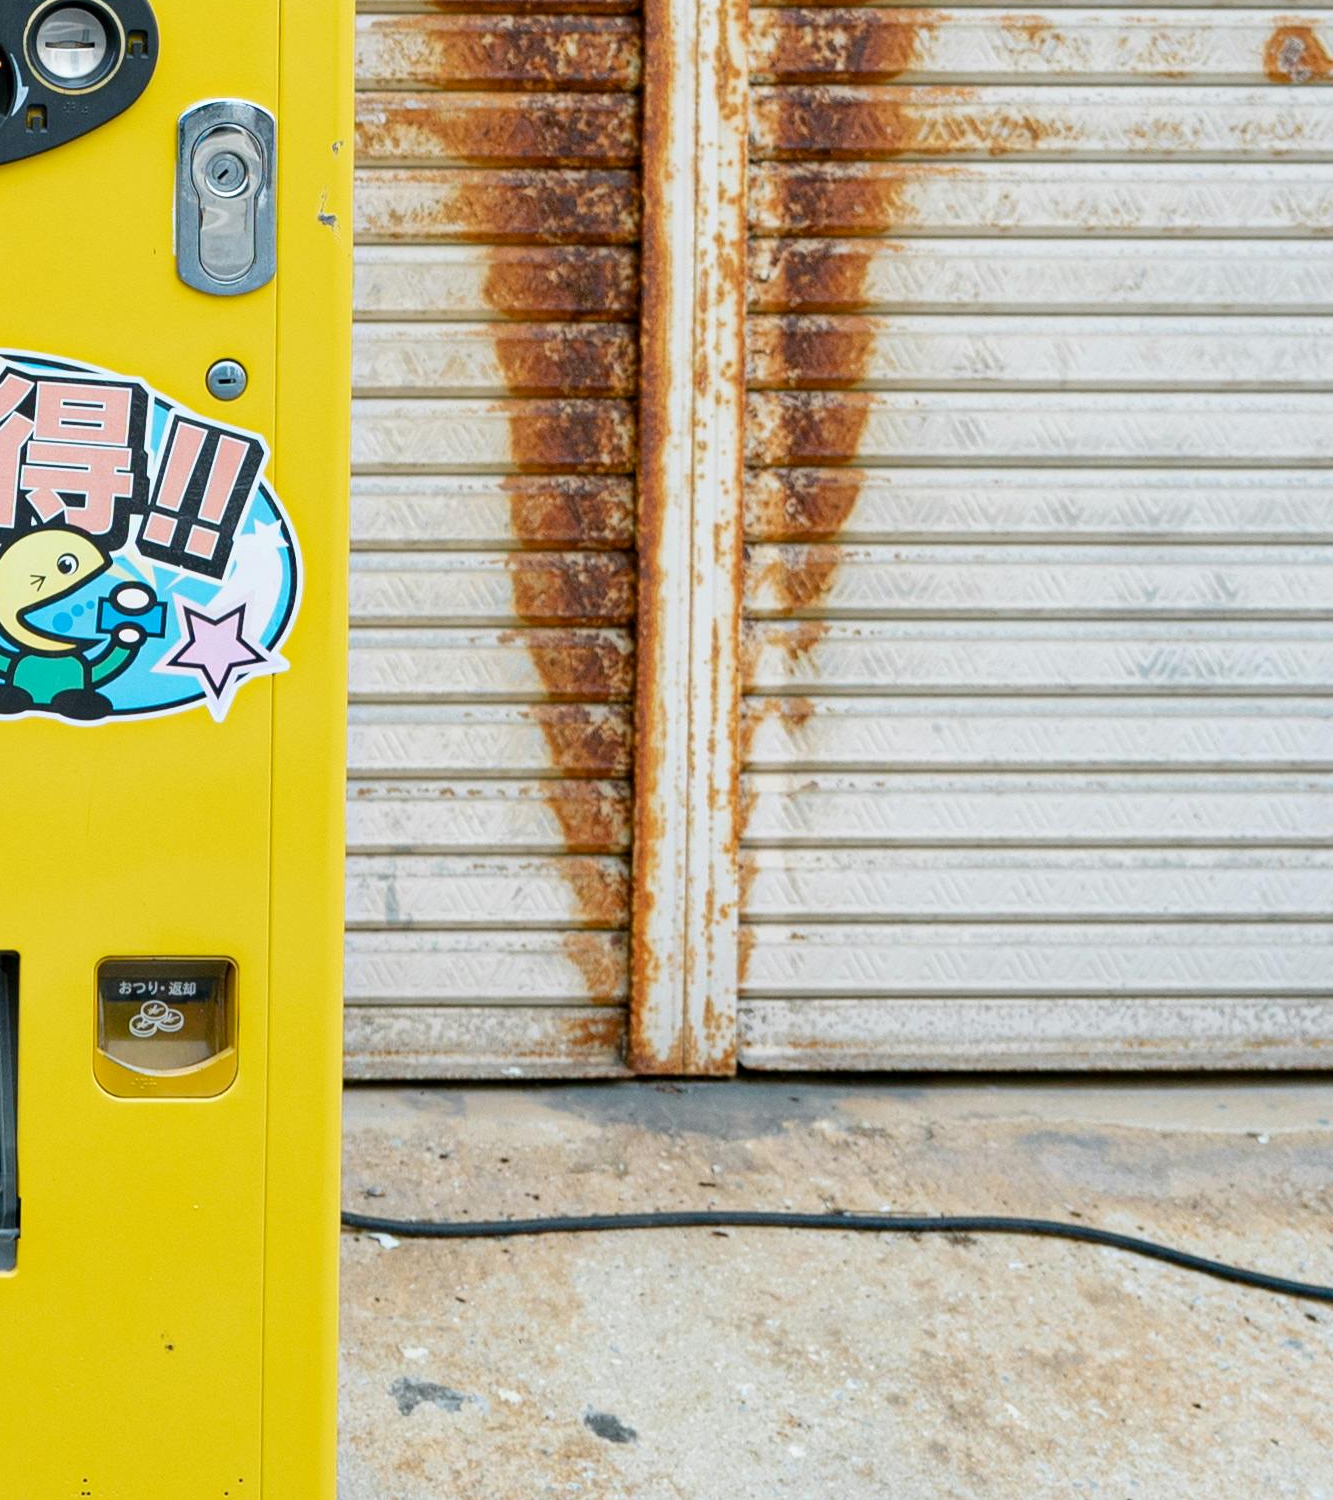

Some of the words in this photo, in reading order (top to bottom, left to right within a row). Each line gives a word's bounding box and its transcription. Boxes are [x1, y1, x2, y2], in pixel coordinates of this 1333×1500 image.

[119, 981, 197, 996] おつり・返却
